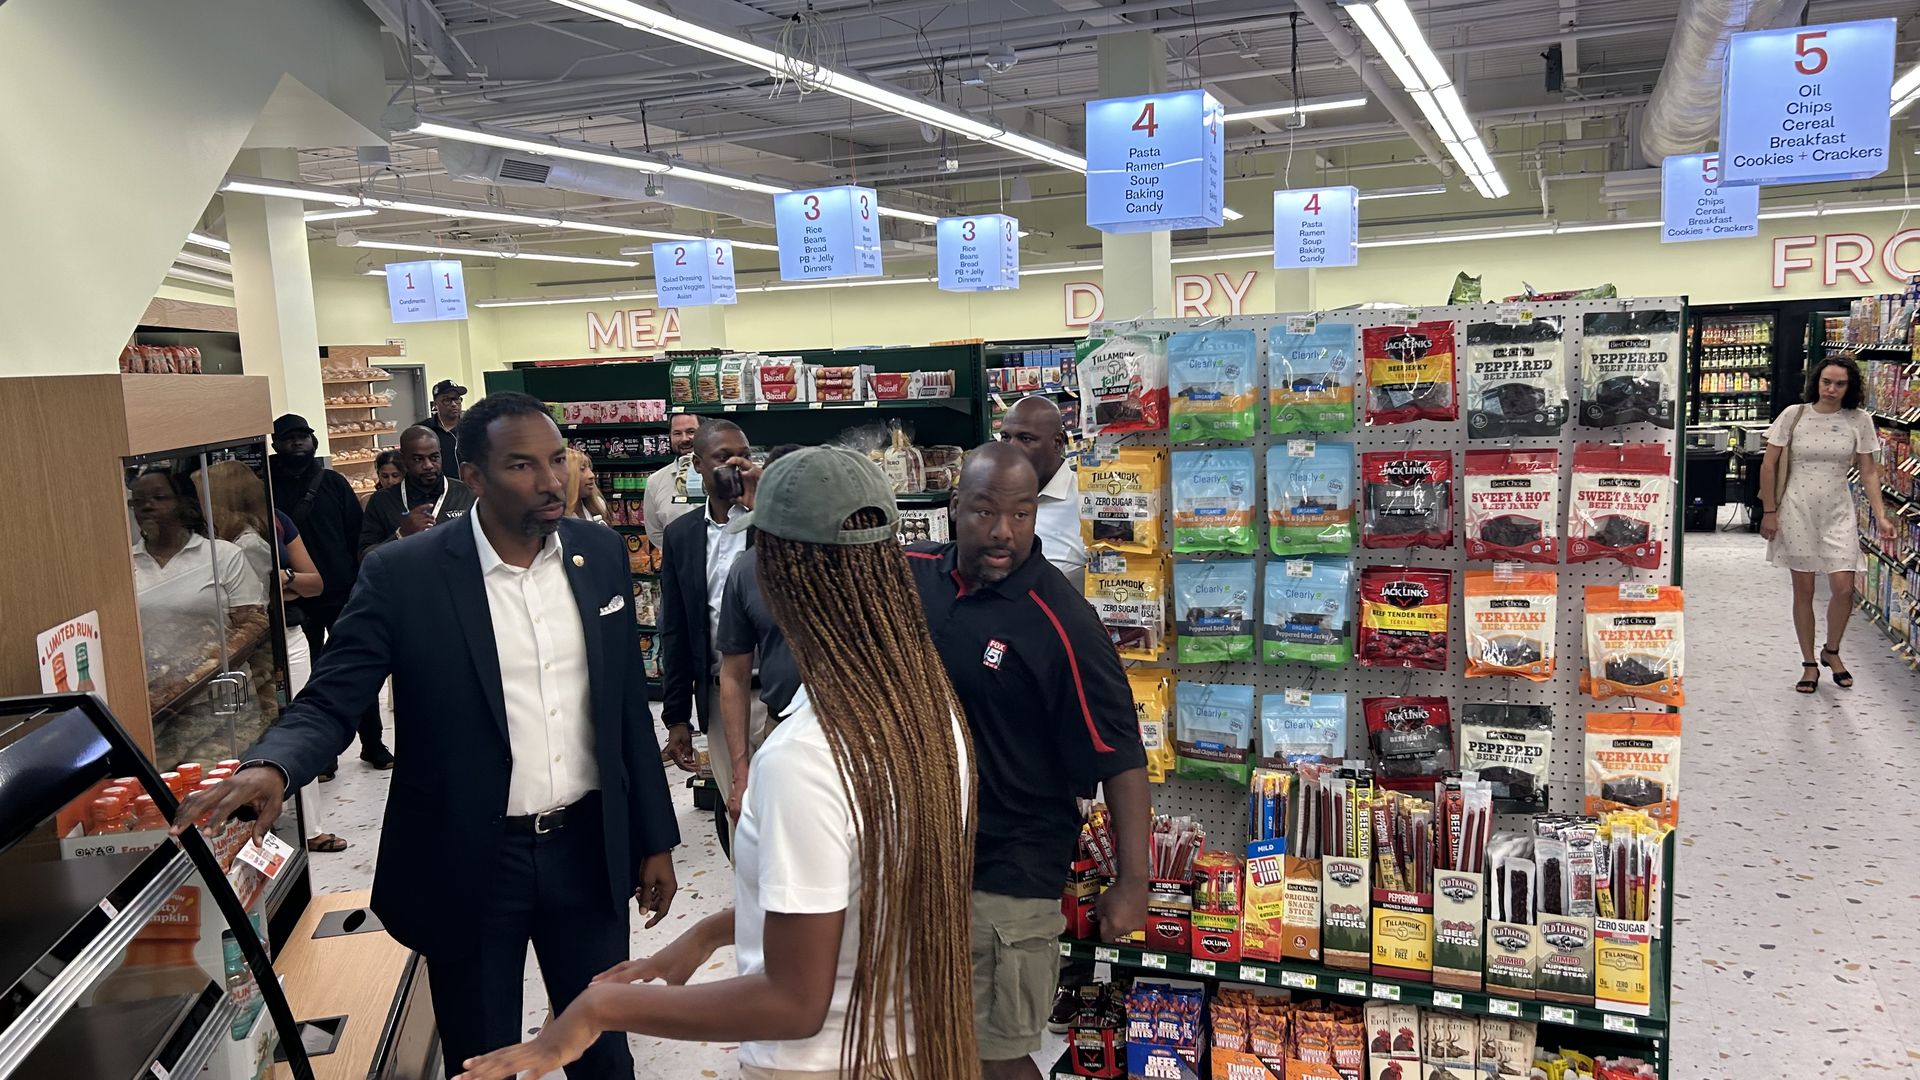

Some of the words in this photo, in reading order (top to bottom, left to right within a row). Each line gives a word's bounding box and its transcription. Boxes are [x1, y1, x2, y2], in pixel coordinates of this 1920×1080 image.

[1794, 31, 1828, 76] 5
[1799, 84, 1821, 97] Oil
[1786, 101, 1832, 116] Chips
[1132, 102, 1159, 137] 4
[1782, 116, 1835, 131] Cereal
[1770, 133, 1846, 149] Breakfast
[1129, 147, 1160, 158] Pasta
[1734, 154, 1794, 168] Cookies
[1813, 147, 1883, 162] Crackers
[1126, 161, 1164, 172] Ramen
[1702, 159, 1719, 183] 5
[1130, 175, 1159, 187] Soup
[1125, 188, 1164, 200] Baking
[1705, 188, 1717, 196] Oil
[860, 195, 869, 220] 3
[1303, 193, 1321, 215] 4
[1698, 197, 1724, 207] Chips
[804, 195, 820, 221] 3
[1126, 202, 1163, 214] Candy
[1696, 207, 1726, 216] Cereal
[1689, 216, 1732, 226] Breakfast
[962, 221, 976, 241] 3
[1006, 221, 1012, 242] 3
[1299, 229, 1325, 237] Ramen
[1668, 227, 1703, 236] Cookies
[1713, 224, 1754, 233] Crackers
[804, 235, 826, 244] Beans
[1302, 238, 1322, 246] Soup
[675, 247, 686, 265] 2
[716, 247, 724, 265] 2
[1300, 247, 1325, 255] Baking
[818, 254, 834, 263] Jelly
[1300, 255, 1325, 263] Candy
[803, 265, 832, 273] Dinners
[405, 272, 415, 289] 1
[444, 272, 453, 289] 1
[1064, 271, 1258, 327] DRY
[1077, 341, 1091, 349] NEW
[1189, 359, 1217, 368] Clearly
[1591, 352, 1668, 365] PEPPERED
[1510, 371, 1543, 379] JERKY
[878, 384, 898, 393] Biscoff
[1193, 475, 1221, 484] Clearly
[1615, 479, 1639, 487] Choice
[1095, 497, 1110, 505] ZERO
[1112, 497, 1132, 505] SUGAR
[1472, 493, 1512, 503] SWEET
[1517, 493, 1526, 502] &
[1527, 492, 1550, 501] HOT
[1578, 491, 1620, 501] SWEET
[1623, 492, 1632, 502] &
[1634, 493, 1659, 503] HOT
[1099, 579, 1145, 591] TILLAMOOK
[1196, 585, 1223, 594] Clearly
[1286, 590, 1314, 600] Clearly
[1102, 604, 1117, 612] ZERO
[1118, 605, 1138, 613] SUGAR
[1475, 613, 1547, 623] TERIYAKI
[45, 623, 75, 659] LIMITED
[77, 622, 92, 638] RUN
[1276, 631, 1300, 639] Peppered
[1314, 632, 1329, 641] Jerky
[1598, 629, 1673, 641] TERIYAKI
[990, 640, 1006, 650] FOX
[986, 648, 1000, 663] 5
[1196, 708, 1221, 718] Clearly
[1284, 720, 1313, 730] Clearly
[1469, 742, 1543, 757] PEPPERED
[1595, 752, 1668, 764] TERIYAKI
[1360, 811, 1368, 832] BEEF
[1360, 834, 1369, 856] STICK
[1339, 864, 1362, 874] TRAPPER
[1451, 879, 1476, 891] TRAPPER
[1285, 893, 1319, 902] ORIGINAL
[1388, 893, 1418, 905] PEPPERONI
[1288, 901, 1314, 909] SNACK
[1289, 908, 1313, 916] STICK
[1326, 919, 1366, 928] STICKS
[1386, 920, 1420, 931] TILLAMOOK
[1597, 920, 1616, 931] ZERO
[1618, 922, 1645, 933] SUGAR
[1444, 929, 1472, 938] BEEF
[1492, 928, 1503, 936] OLD
[1504, 928, 1529, 940] TRAPPER
[1542, 924, 1556, 935] OLD
[1556, 923, 1588, 938] TRAPPER
[1437, 935, 1479, 947] STICKS
[1605, 951, 1639, 962] TILLAMOOK
[1493, 964, 1528, 973] KIPPERED
[1546, 963, 1584, 972] KIPPERED
[1509, 971, 1533, 979] STEAK
[1148, 1056, 1176, 1067] BEEF
[1145, 1064, 1181, 1079] BITES
[1227, 1062, 1265, 1074] TURKEY
